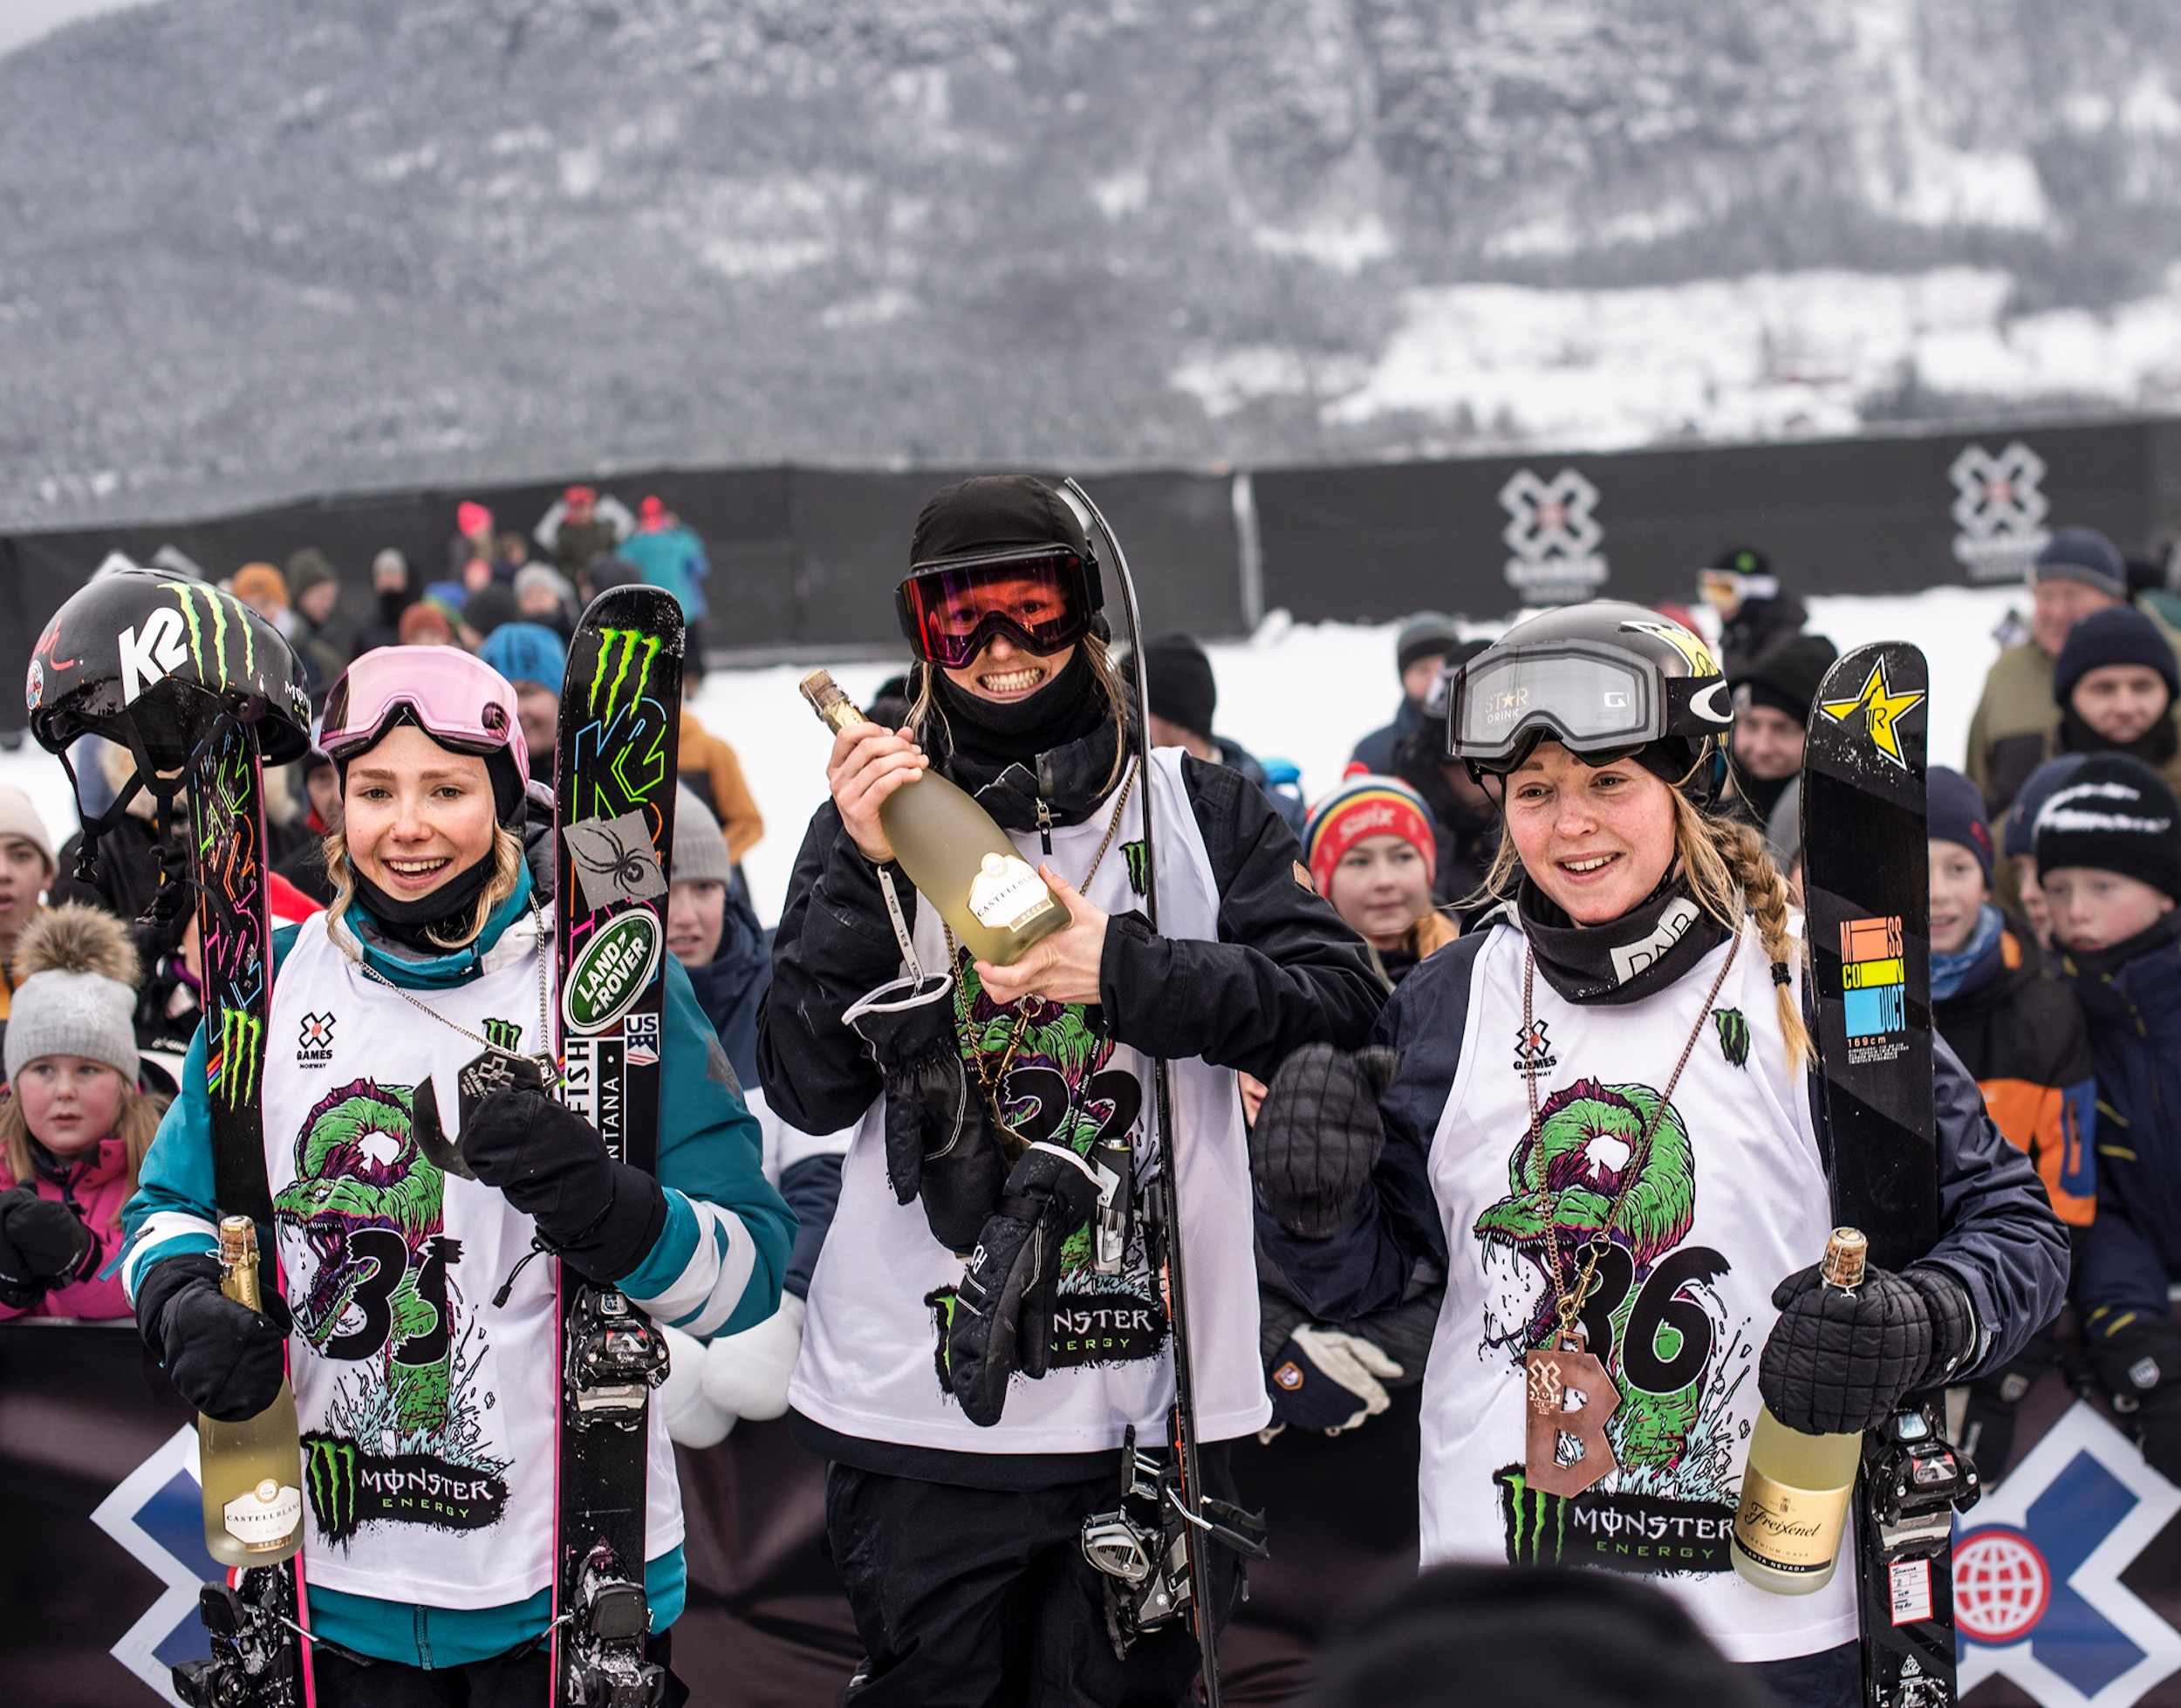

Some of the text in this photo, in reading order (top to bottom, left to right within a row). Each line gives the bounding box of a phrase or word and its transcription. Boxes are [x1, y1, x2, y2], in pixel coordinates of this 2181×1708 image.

[119, 608, 188, 706] K2
[1487, 708, 1519, 724] DRINK
[578, 939, 622, 1003] LAND
[597, 936, 648, 1010] ROVER
[626, 1015, 657, 1034] US
[297, 1049, 332, 1061] GAMES
[1091, 1038, 1101, 1061] ROXY
[567, 1041, 590, 1117] FISH
[1081, 1074, 1090, 1096] ROXY
[602, 1076, 619, 1159] NTANA
[1070, 1109, 1080, 1130] ROXY
[1053, 1308, 1154, 1335] NSTER
[1049, 1338, 1130, 1352] NERGY
[360, 1468, 494, 1501] MONSTER
[383, 1498, 471, 1520] ENERGY
[1745, 1501, 1822, 1537] Freixenet
[1574, 1506, 1733, 1540] MONSTER
[258, 1539, 283, 1548] SECO
[1596, 1541, 1715, 1560] ENERGY
[1770, 1561, 1805, 1572] NEVADA
